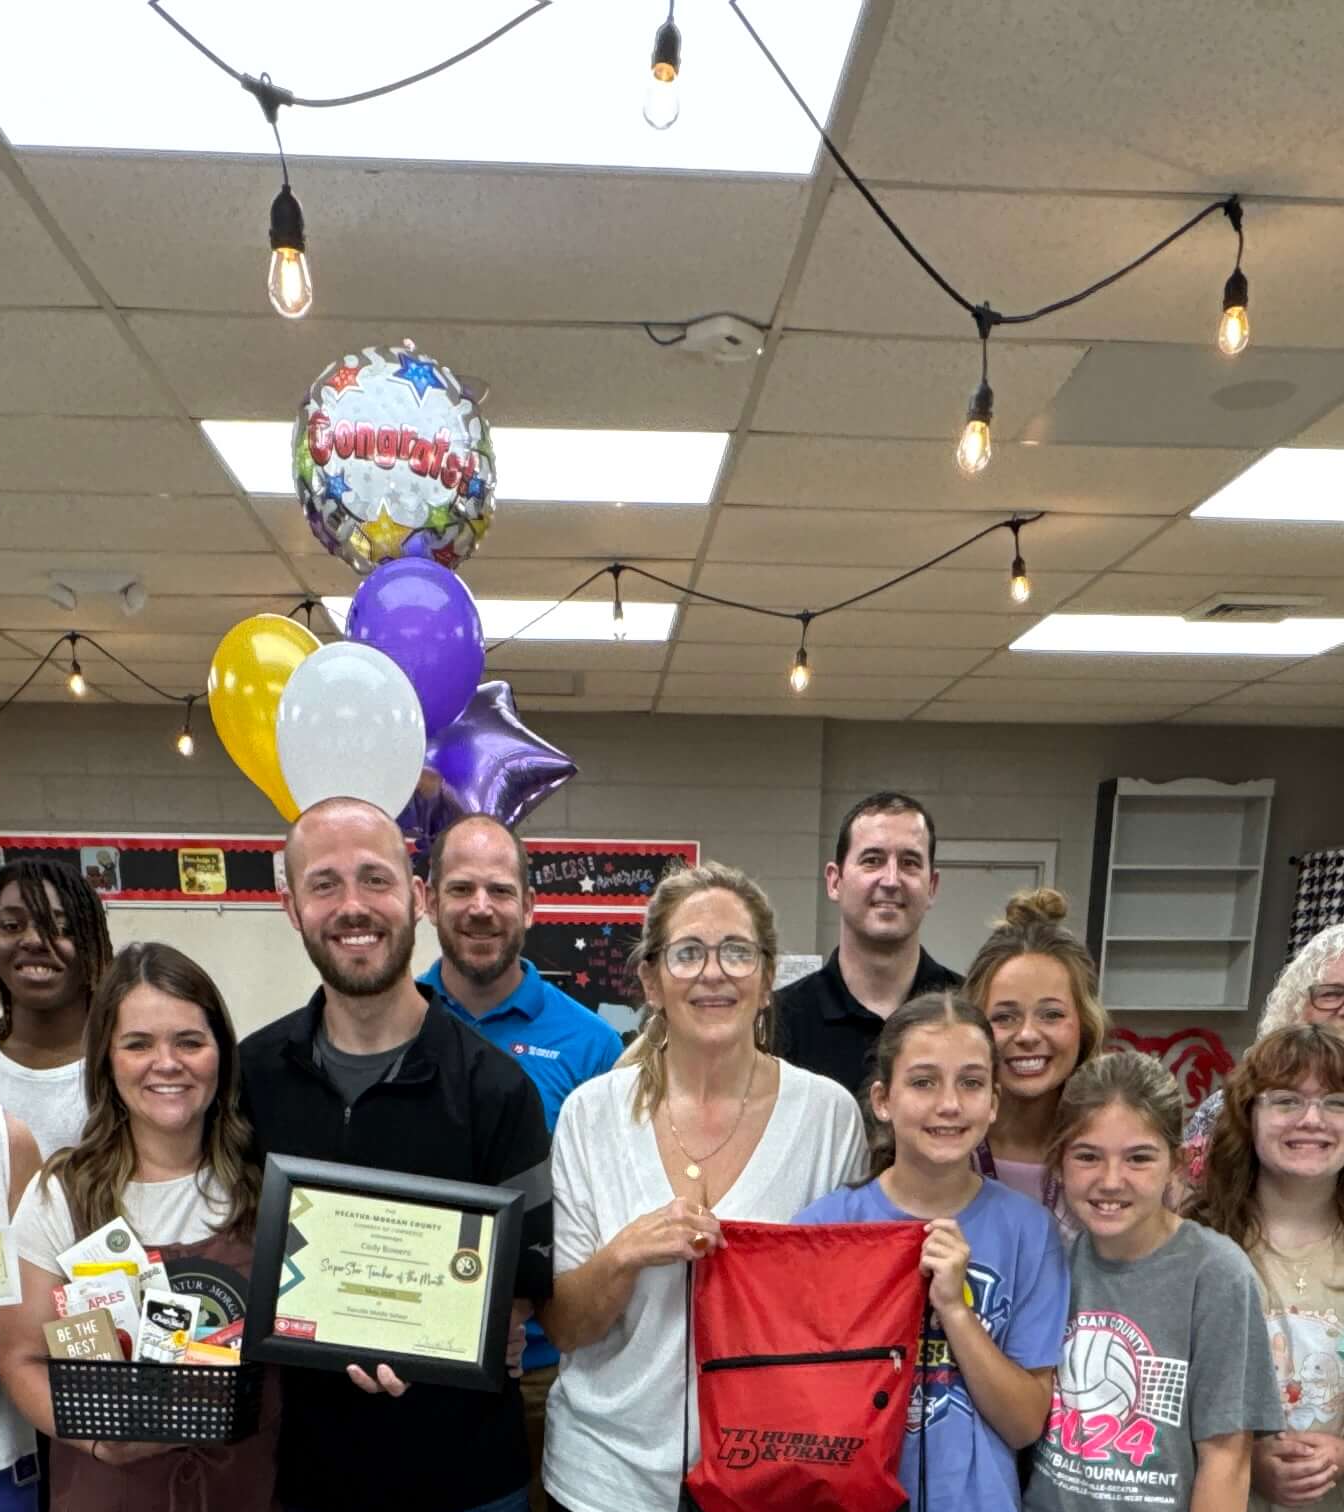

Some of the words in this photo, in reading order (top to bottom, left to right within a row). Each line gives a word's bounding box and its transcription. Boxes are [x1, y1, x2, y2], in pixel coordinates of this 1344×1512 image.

[410, 1220, 442, 1231] COUNTY
[56, 1328, 72, 1342] BE
[75, 1319, 99, 1336] THE
[1110, 1317, 1147, 1352] COUNTY
[67, 1338, 96, 1357] BEST
[761, 1431, 864, 1450] HUBBARD
[783, 1445, 856, 1461] DRAKE
[1083, 1465, 1178, 1487] OURNAMENT
